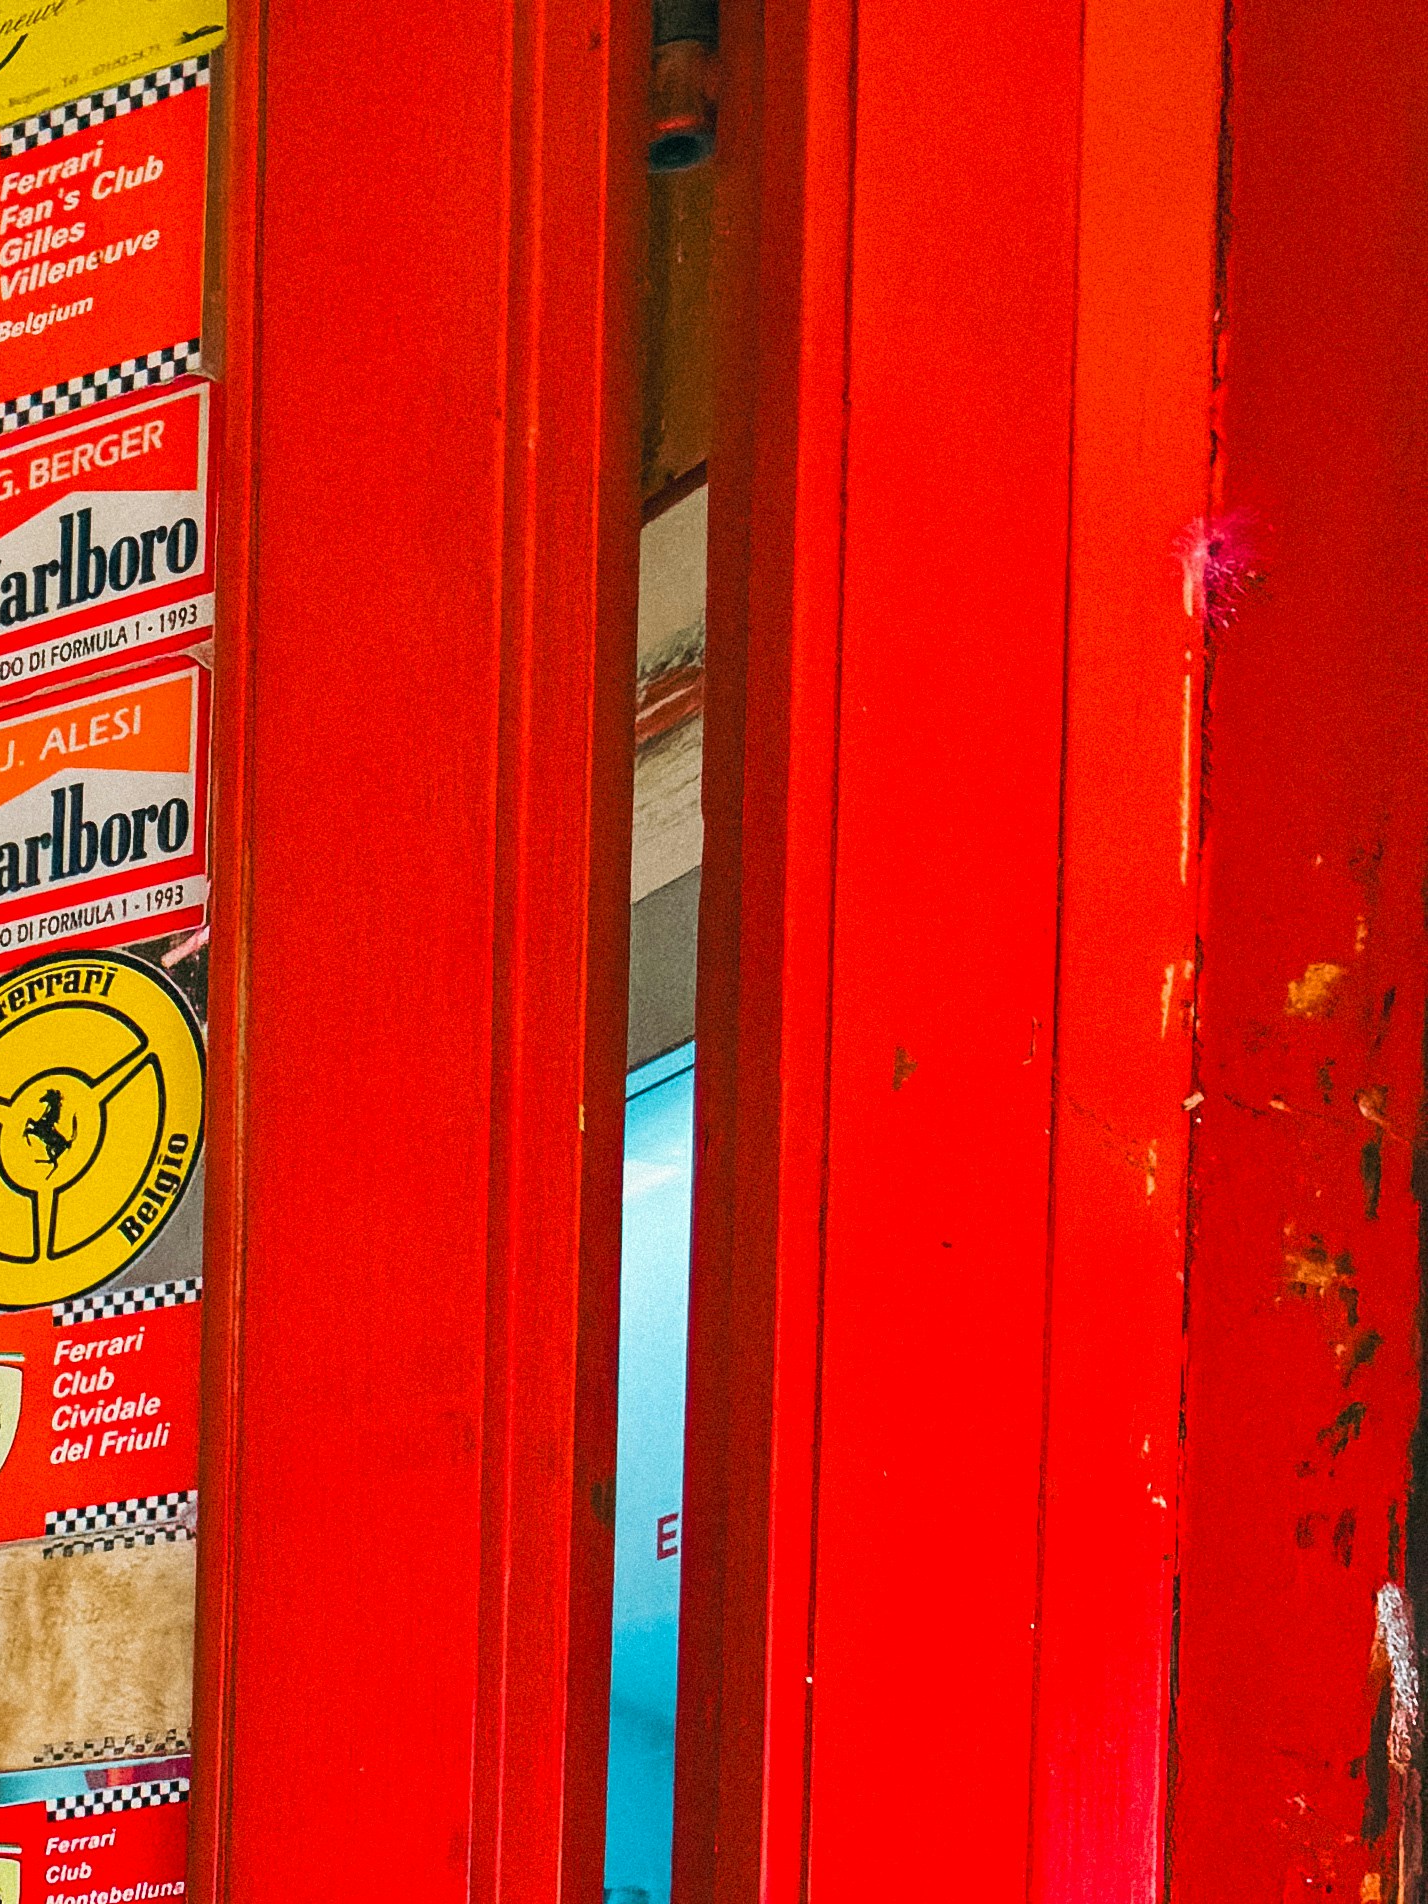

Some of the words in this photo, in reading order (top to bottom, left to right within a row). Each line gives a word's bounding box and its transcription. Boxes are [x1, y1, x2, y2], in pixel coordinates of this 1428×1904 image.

[0, 145, 103, 199] Ferrari
[92, 155, 162, 202] Club
[29, 420, 163, 491] BERGER
[28, 651, 46, 675] DI
[49, 625, 124, 672] FORMULA
[157, 602, 199, 634] 1993
[40, 706, 142, 759] ALESI
[119, 1131, 189, 1249] Belgio
[53, 1328, 145, 1367] Ferrari
[53, 1368, 115, 1398] Club
[51, 1394, 160, 1431] Cividale
[50, 1438, 95, 1464] del
[102, 1423, 170, 1459] Friuli
